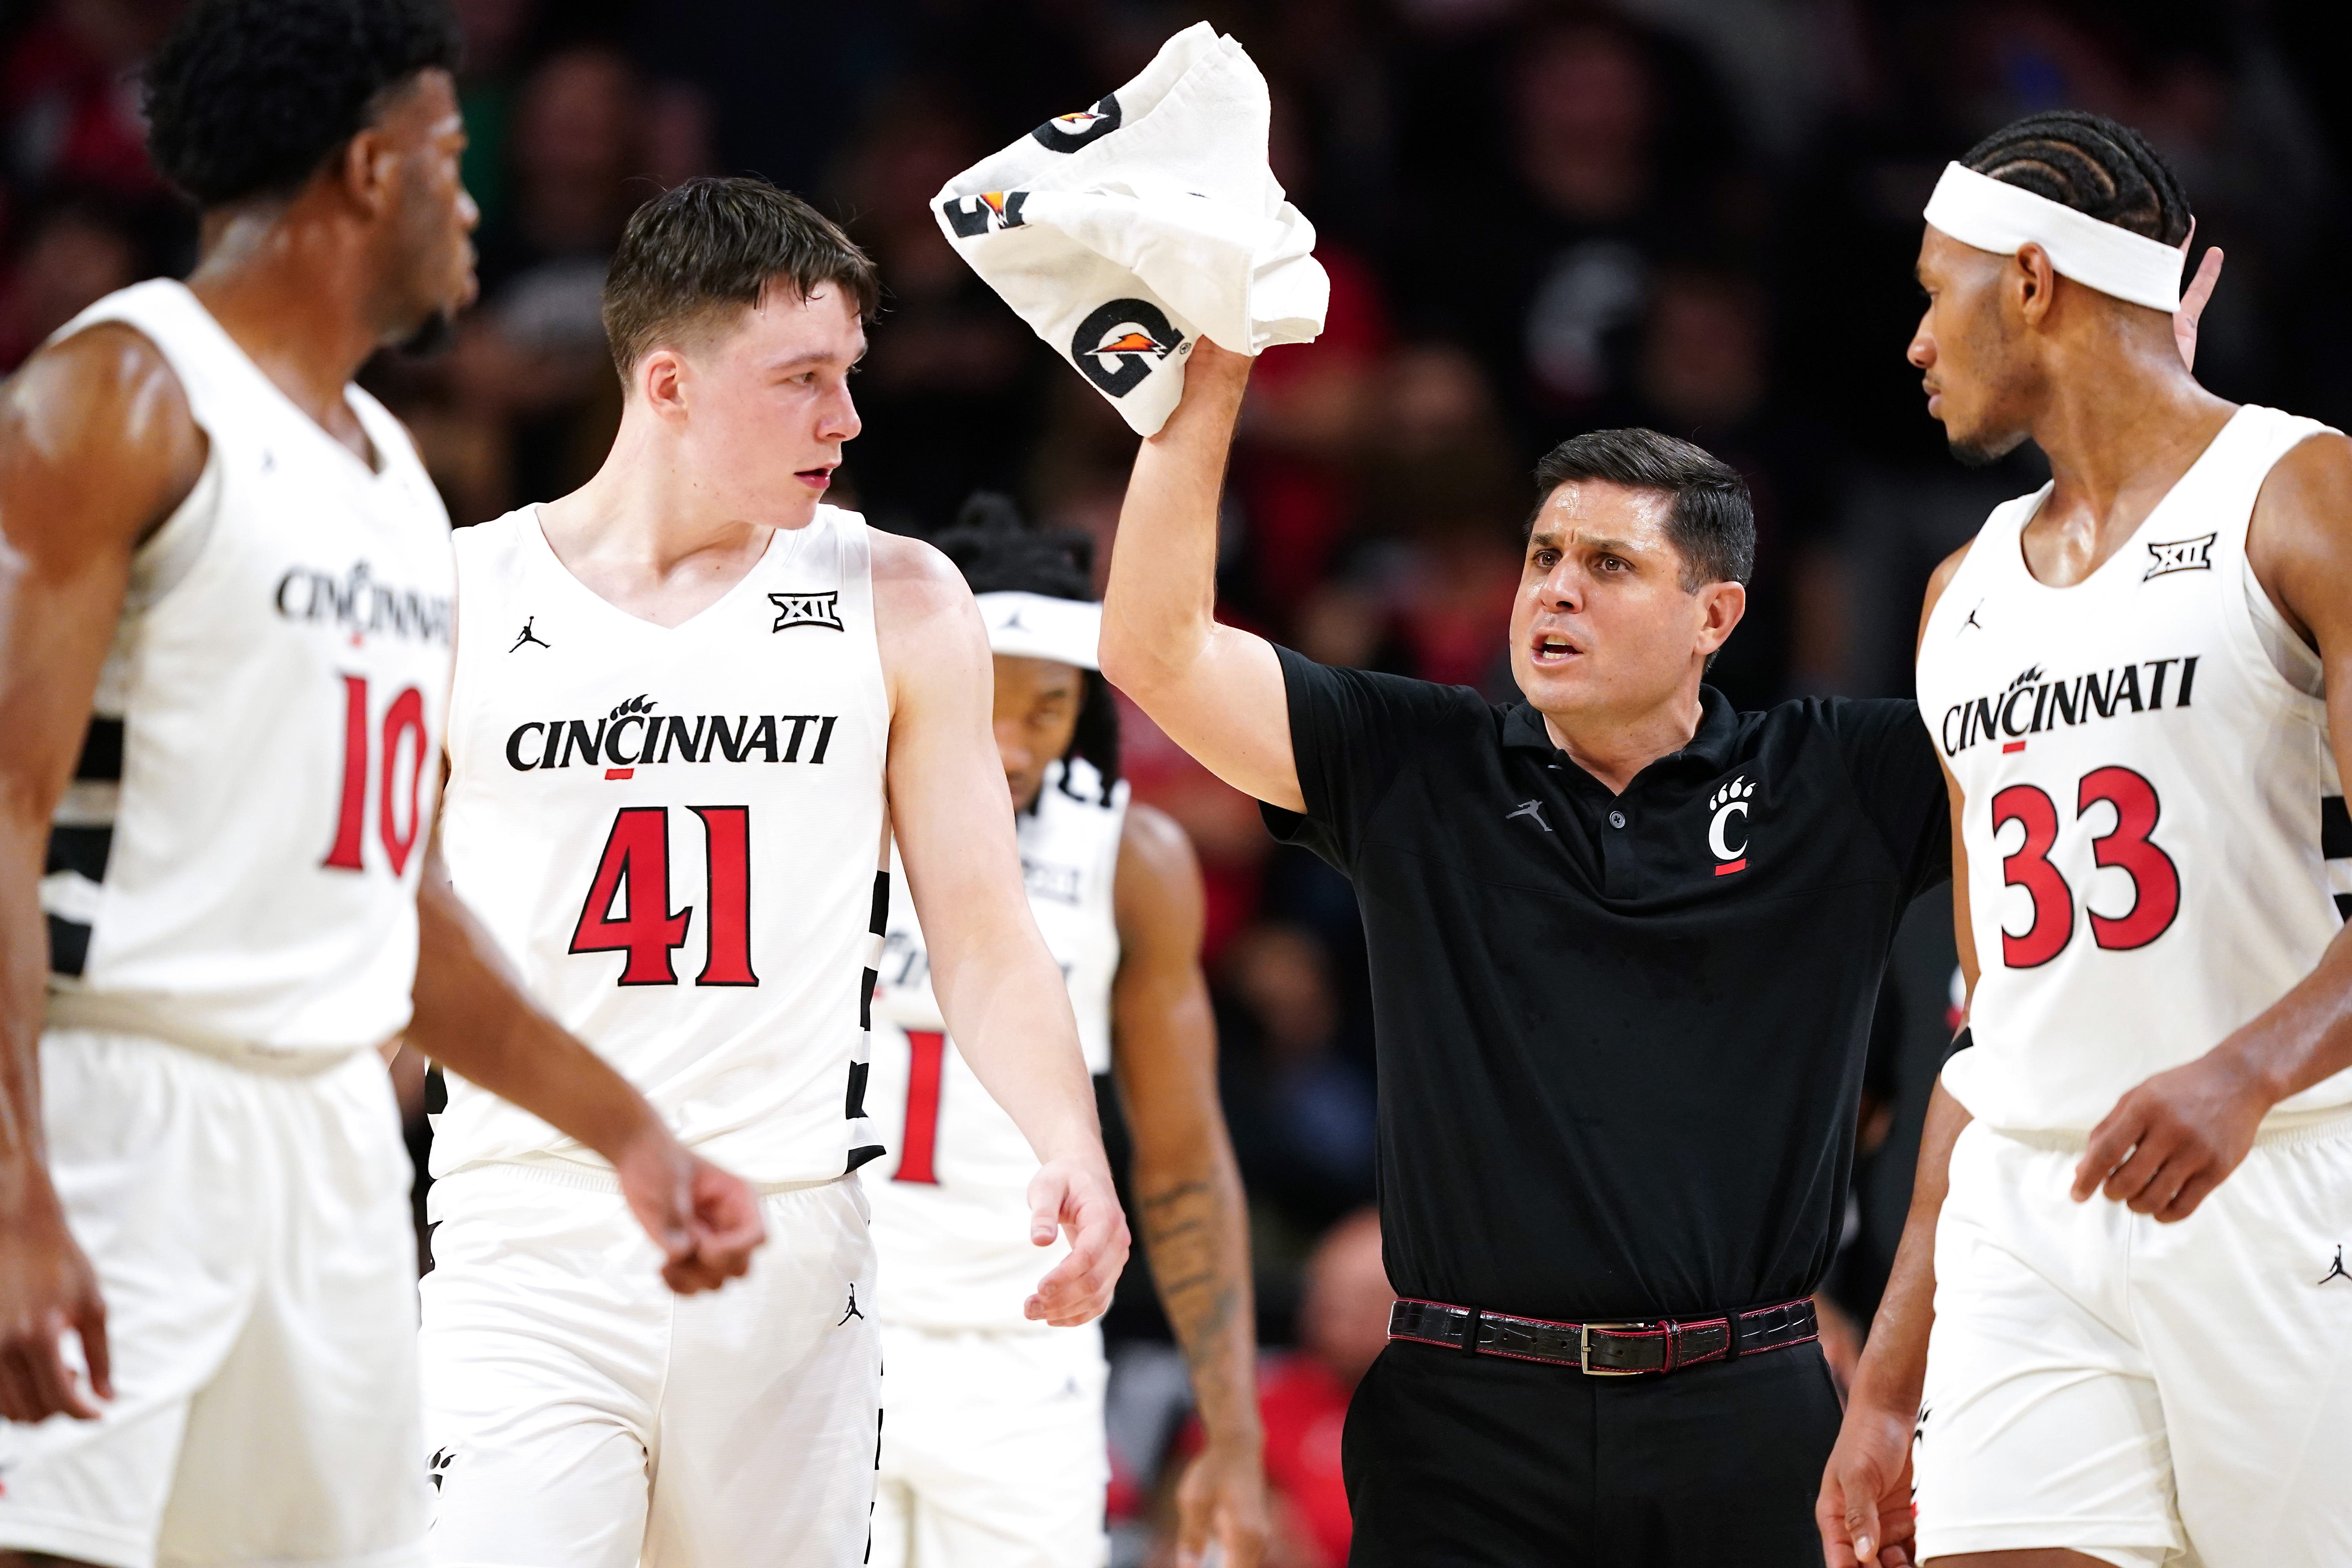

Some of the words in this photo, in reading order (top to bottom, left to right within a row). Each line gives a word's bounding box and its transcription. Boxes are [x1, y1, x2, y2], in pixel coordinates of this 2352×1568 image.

[1071, 298, 1185, 398] G
[2142, 532, 2217, 582] XII
[768, 590, 844, 633] XII
[506, 715, 838, 771] CINCINNATI
[1942, 655, 2201, 757] CINCINNATI
[318, 670, 428, 880] 10
[568, 805, 759, 987] 41
[1991, 765, 2181, 969] 33
[892, 1026, 946, 1185] 1
